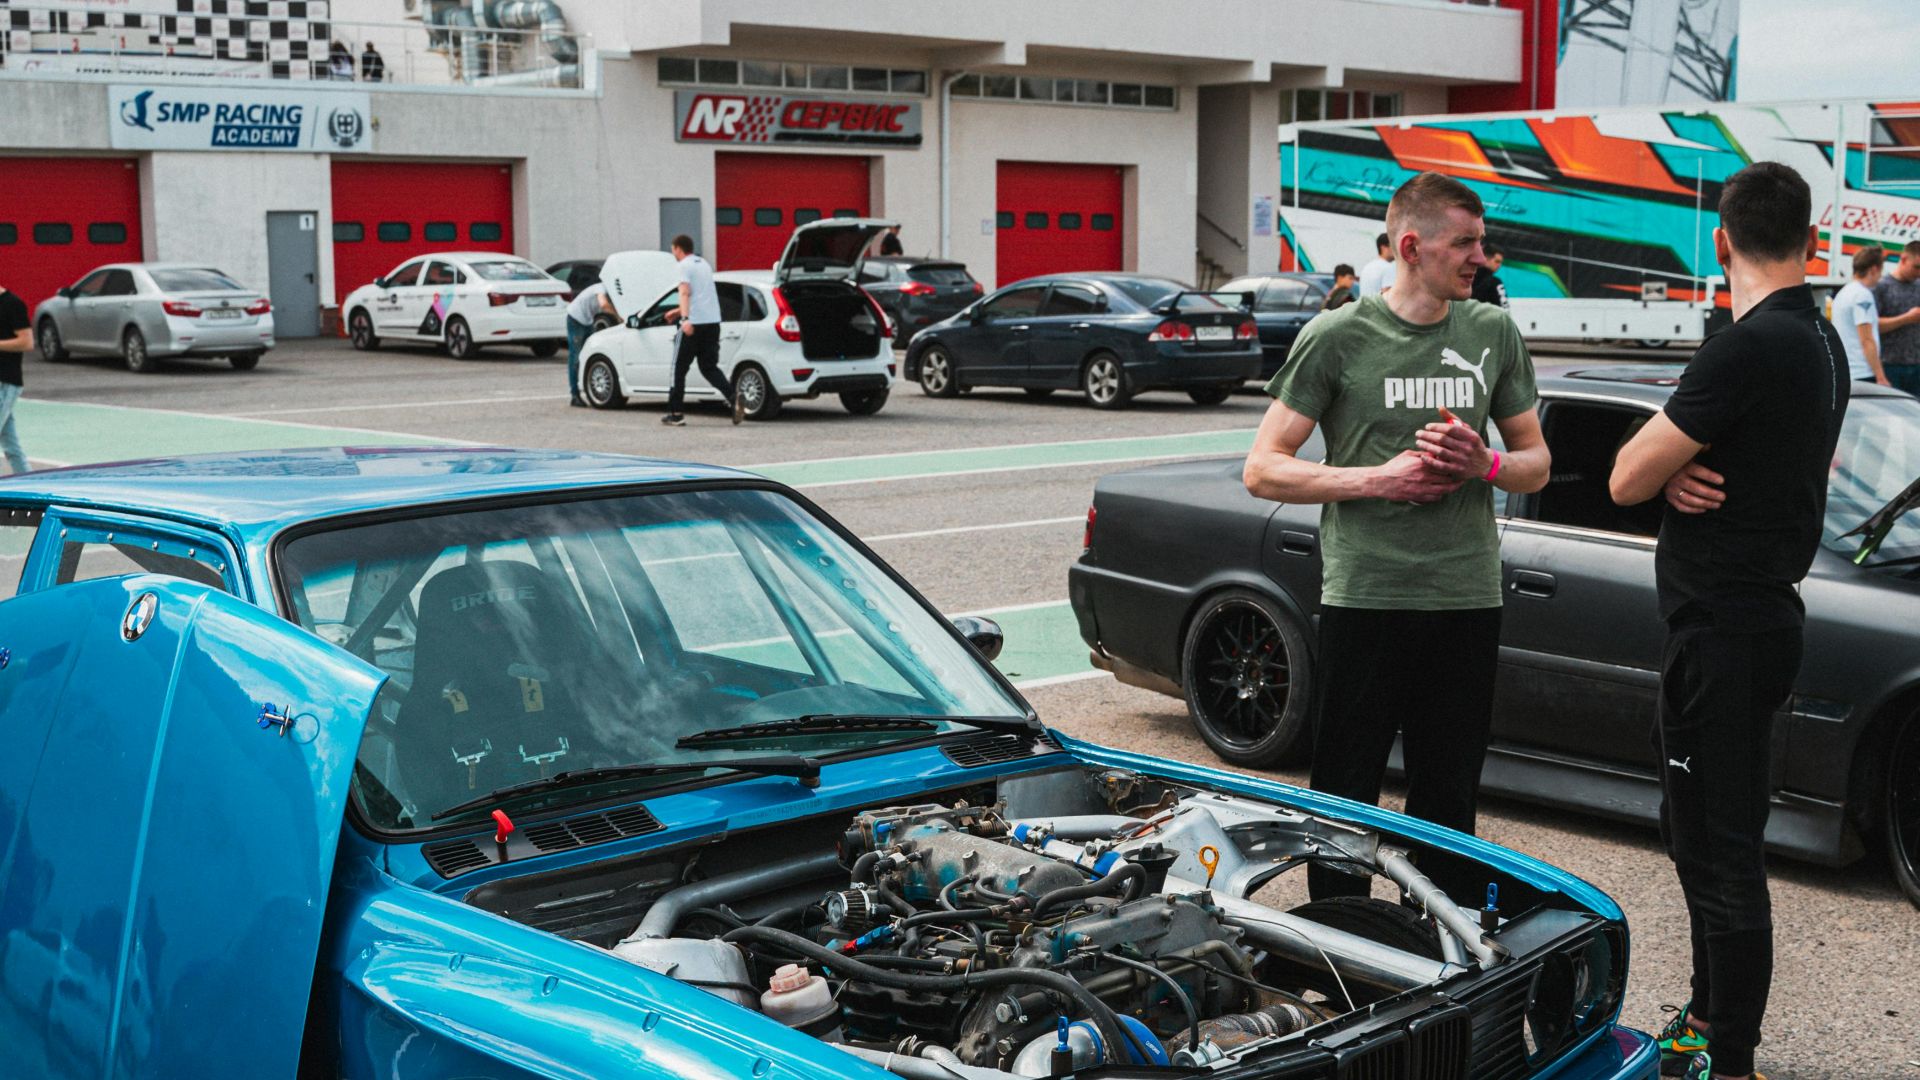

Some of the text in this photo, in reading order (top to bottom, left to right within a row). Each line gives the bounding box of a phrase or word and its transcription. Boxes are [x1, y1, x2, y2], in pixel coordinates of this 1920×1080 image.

[157, 102, 303, 125] SMP RACING
[687, 98, 745, 135] NR
[782, 100, 911, 132] СЕРВИС
[216, 129, 297, 145] ACADEMY
[305, 217, 310, 227] 1
[1886, 212, 1920, 229] NR
[1384, 377, 1474, 409] PUMA
[450, 585, 537, 612] BRIDE
